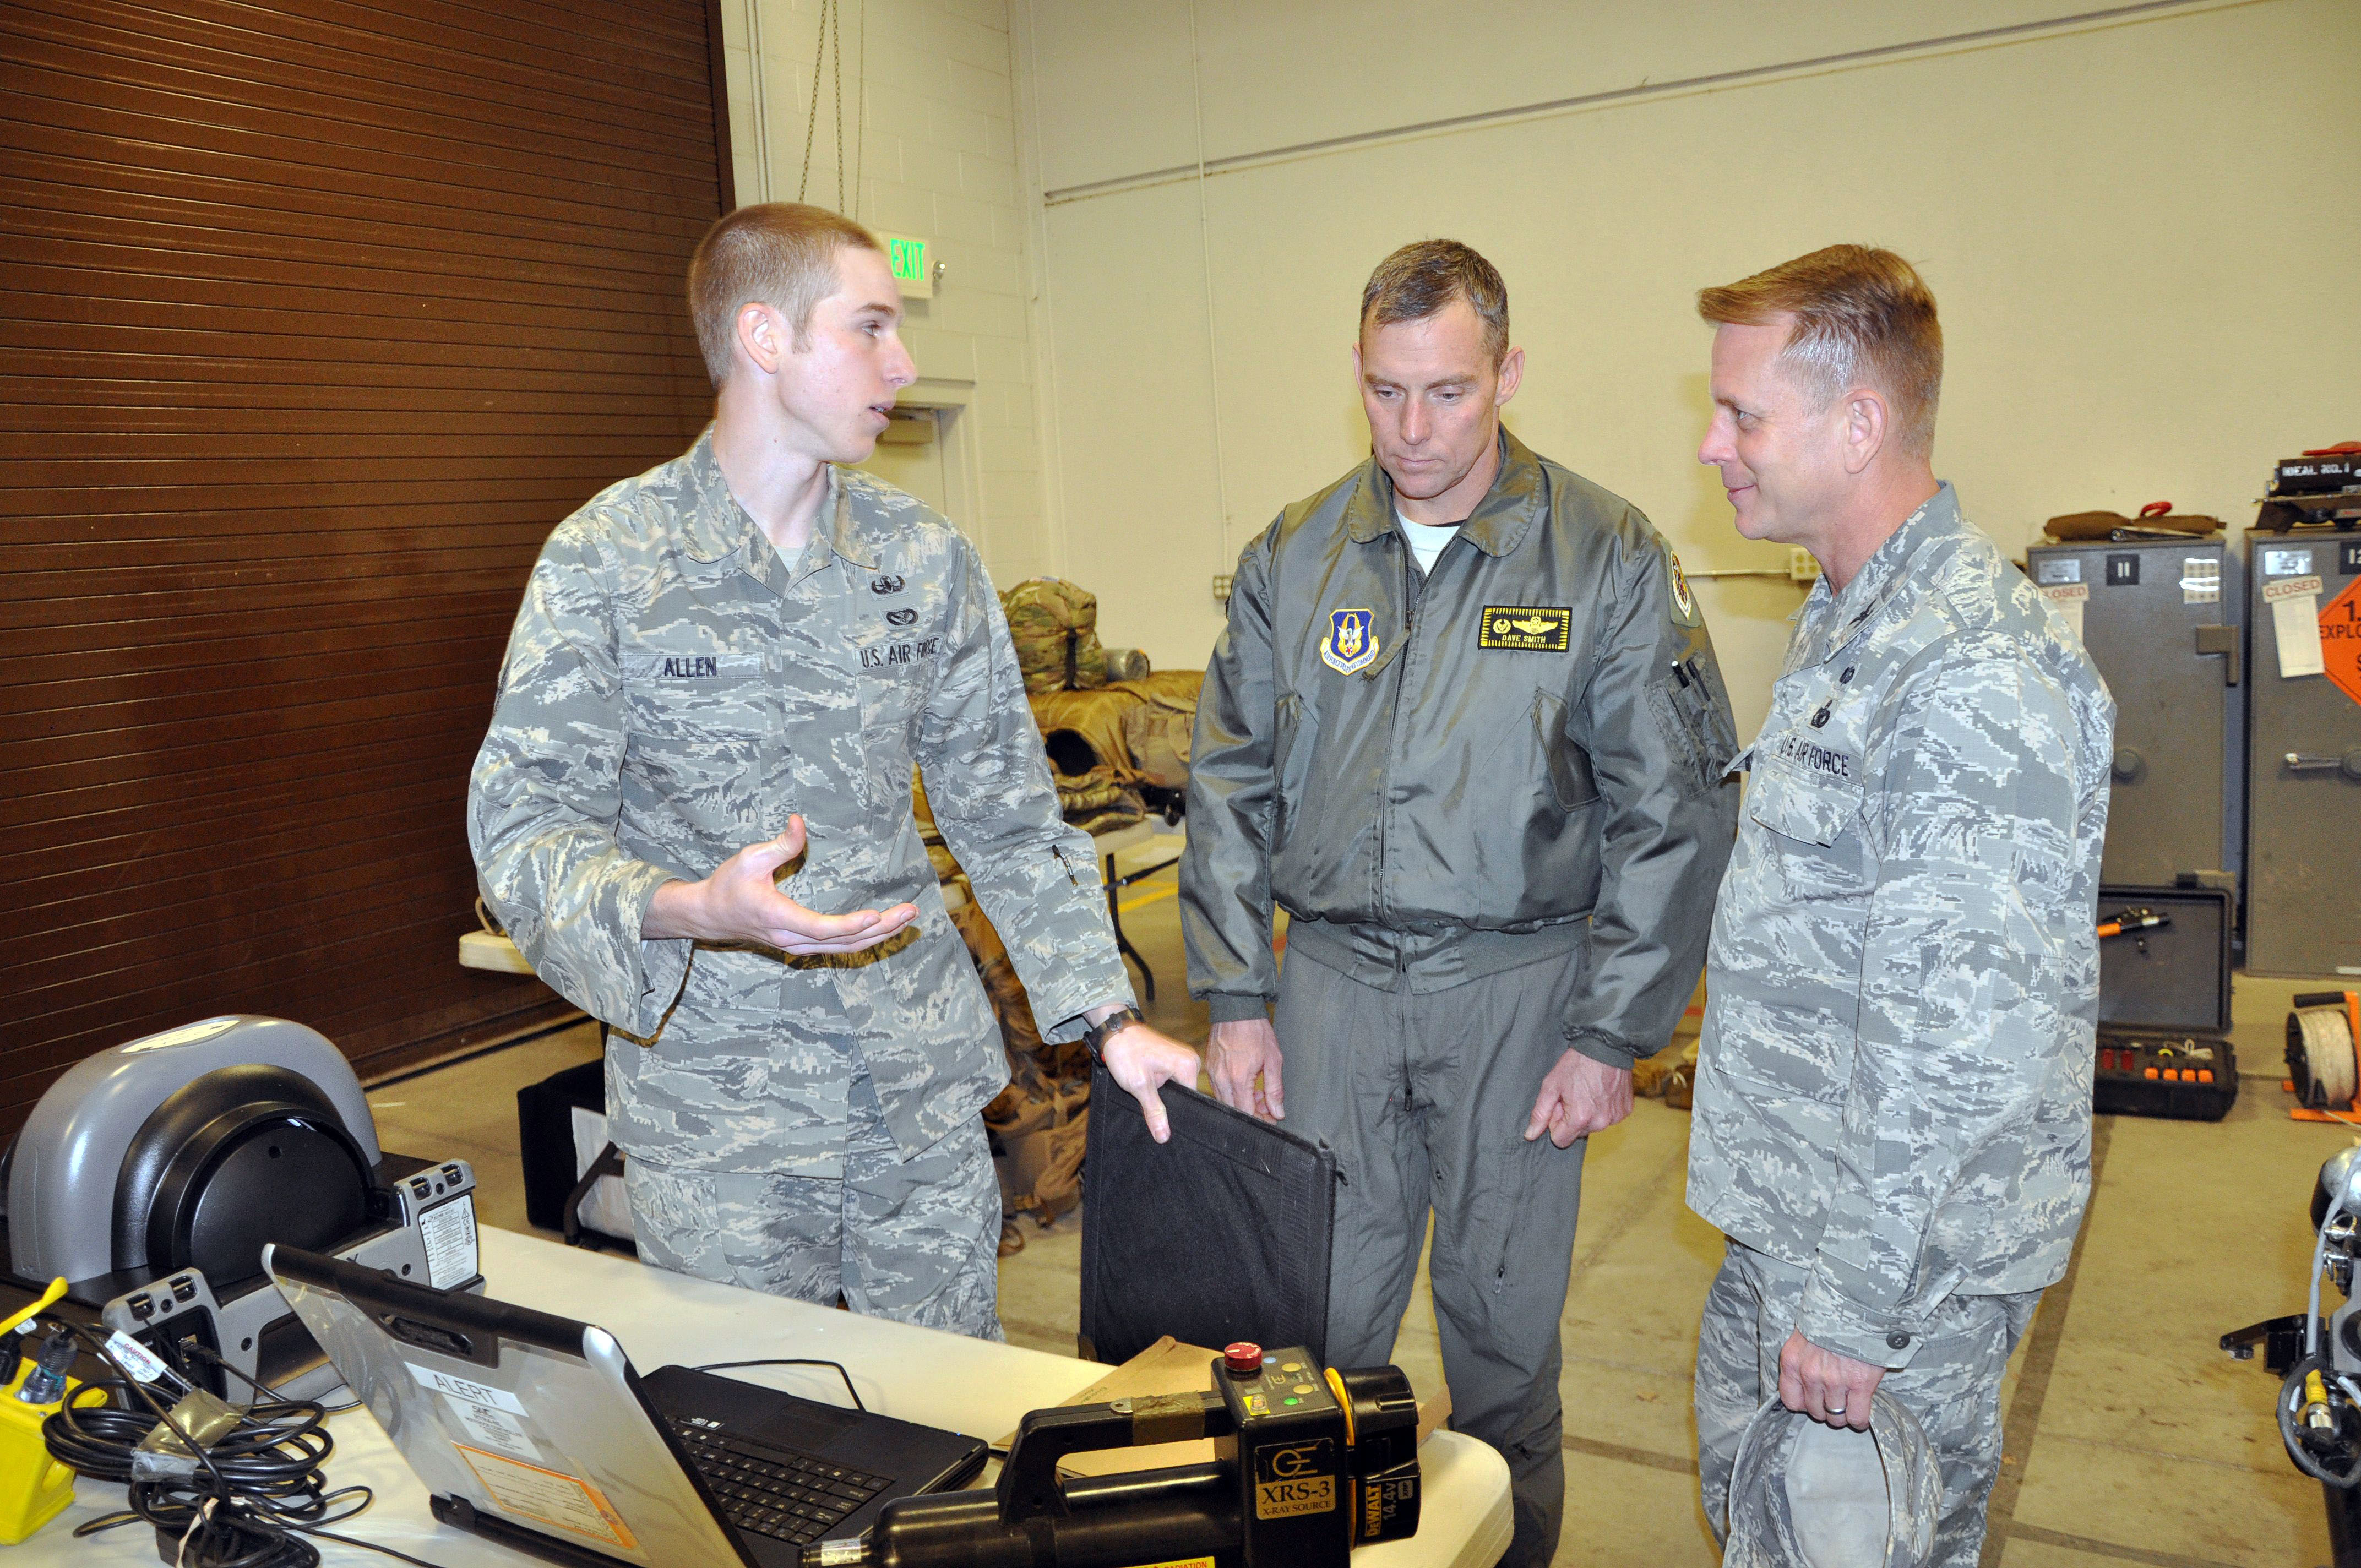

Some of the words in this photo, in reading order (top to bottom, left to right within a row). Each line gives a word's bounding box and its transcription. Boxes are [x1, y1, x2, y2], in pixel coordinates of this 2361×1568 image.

[889, 238, 926, 281] EXIT
[2043, 586, 2086, 600] LOSED
[2265, 579, 2320, 598] CLOSED
[1502, 634, 1521, 642] DAVE
[1524, 635, 1546, 643] SMITH
[664, 656, 717, 678] ALLEN
[860, 649, 884, 668] U.S.
[889, 644, 911, 665] AIR
[1794, 741, 1810, 764] AIR
[1808, 745, 1849, 777] FORCE
[124, 1343, 151, 1364] CAUTION
[433, 1374, 497, 1405] ALERT
[1261, 1480, 1330, 1505] XRS-3
[1263, 1506, 1290, 1515] X-RAY
[1292, 1501, 1331, 1512] SOURCE
